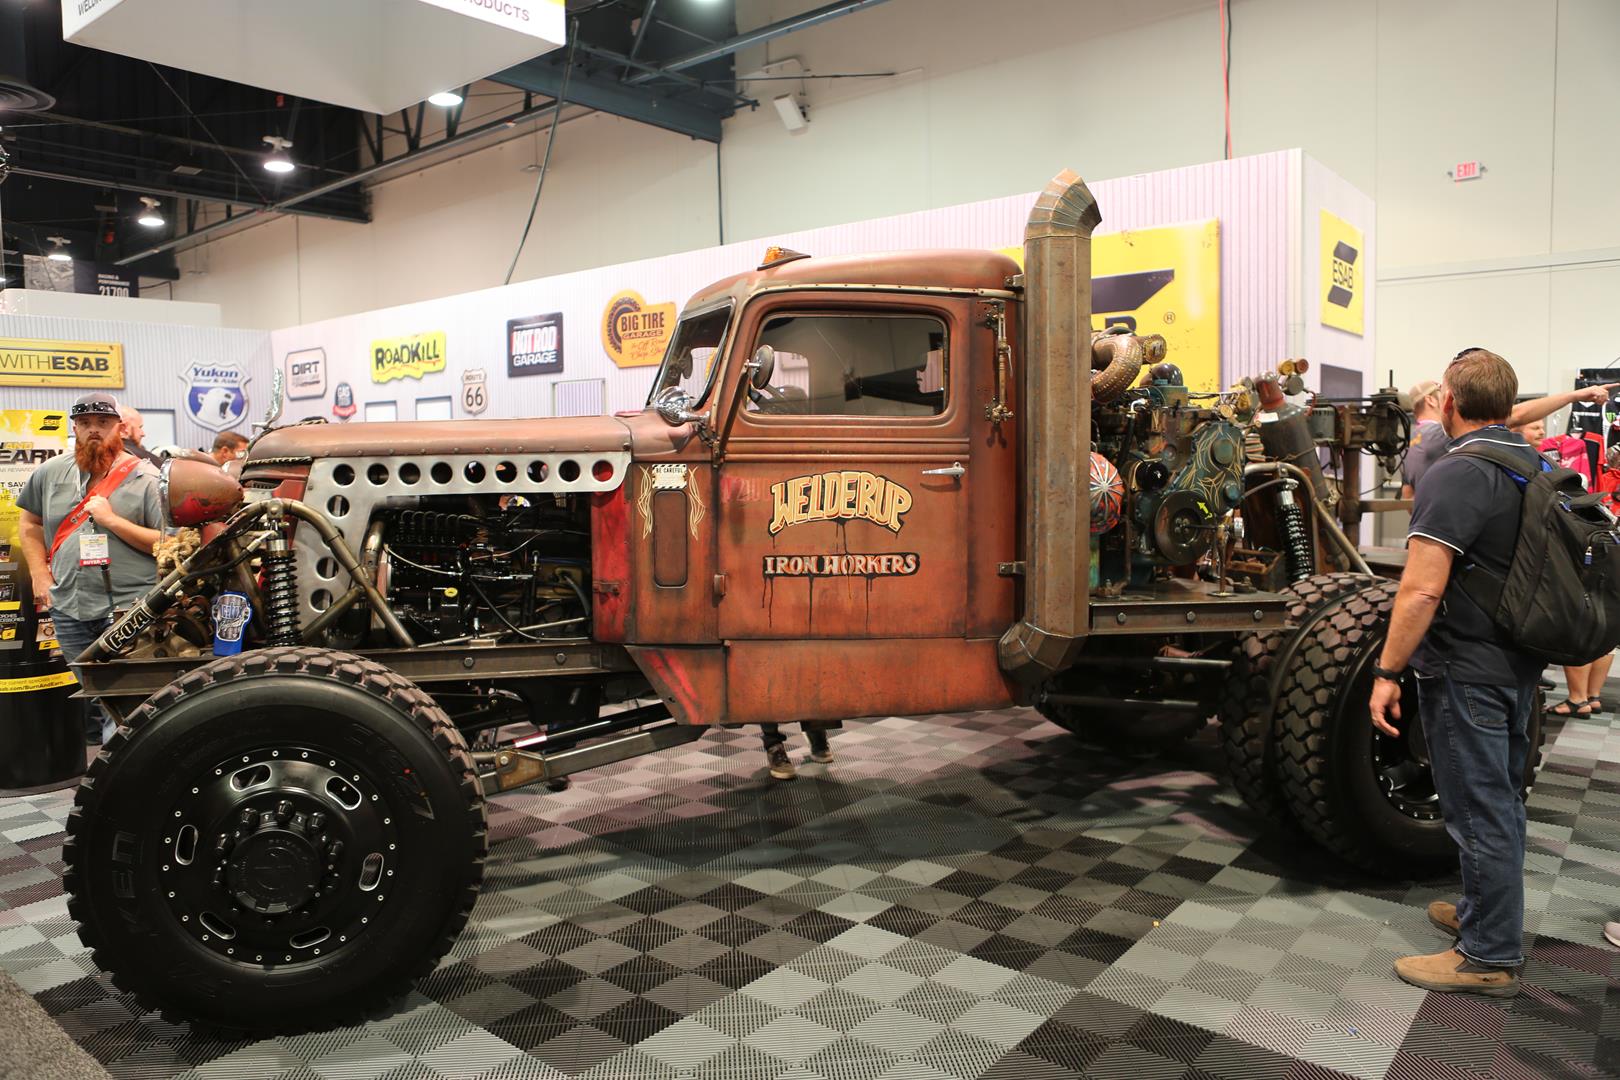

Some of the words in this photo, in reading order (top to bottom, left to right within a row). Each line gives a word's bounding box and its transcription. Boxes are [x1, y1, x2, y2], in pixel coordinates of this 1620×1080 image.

[1456, 162, 1476, 178] EXIT
[1332, 259, 1354, 289] ESAB
[621, 314, 639, 332] BIG
[641, 311, 665, 330] TIRE
[511, 328, 534, 356] HOT
[534, 325, 558, 353] ROD
[622, 329, 664, 339] GARAGE
[374, 339, 440, 371] ROADKILL
[513, 351, 558, 367] GARAGE
[193, 367, 239, 378] Yukon
[291, 360, 320, 376] DIRT
[465, 386, 484, 408] 66
[769, 471, 913, 534] WELDERUP
[764, 556, 818, 575] IRON
[819, 554, 917, 575] WORKERS
